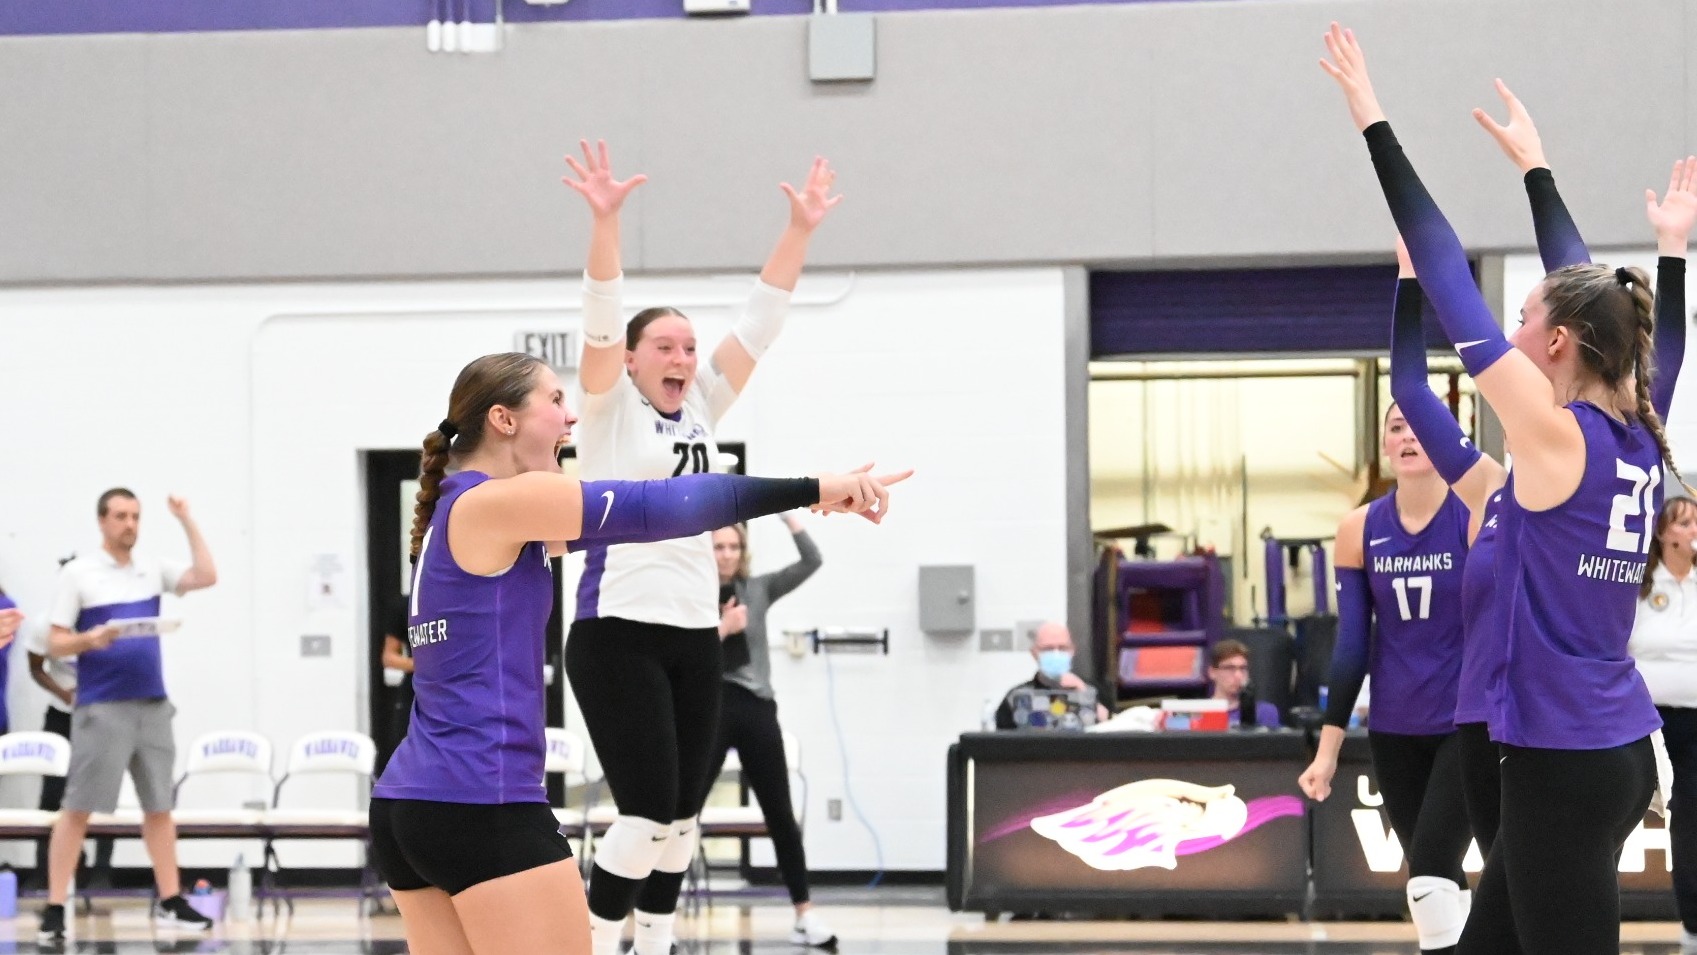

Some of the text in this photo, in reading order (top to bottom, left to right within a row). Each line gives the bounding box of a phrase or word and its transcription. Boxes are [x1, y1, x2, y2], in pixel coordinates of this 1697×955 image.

[525, 333, 568, 366] EXIT
[672, 442, 709, 478] 20
[1606, 457, 1661, 554] 21
[1374, 552, 1453, 573] WARHAWKS
[1392, 576, 1432, 621] 17
